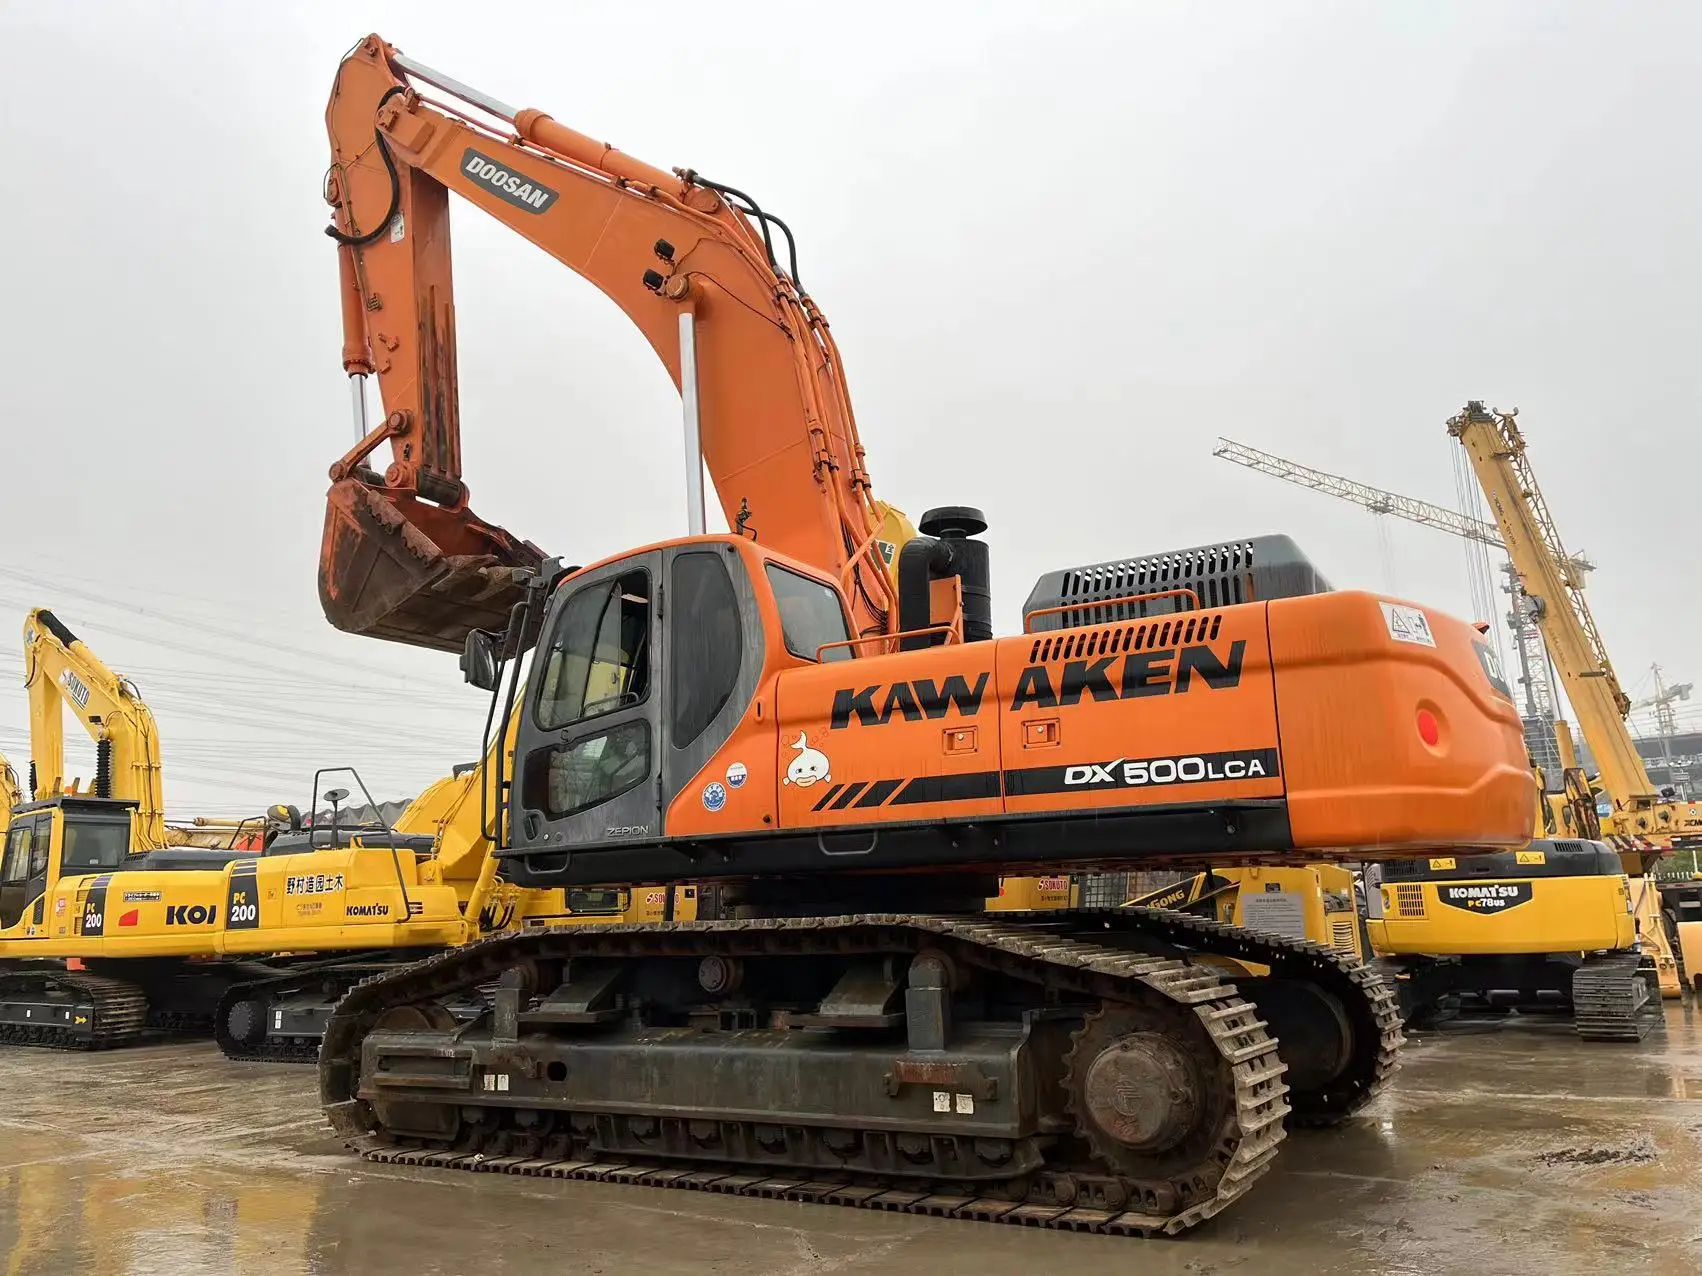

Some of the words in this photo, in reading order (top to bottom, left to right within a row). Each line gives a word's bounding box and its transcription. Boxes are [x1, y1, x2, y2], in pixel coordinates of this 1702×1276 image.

[465, 156, 549, 209] DOOSAN
[607, 825, 649, 837] ZEPION
[286, 874, 344, 895] 野村造园土木
[1449, 885, 1518, 898] KOMATSU
[233, 892, 246, 904] PC
[86, 903, 95, 914] PC
[166, 905, 217, 925] KOI
[231, 905, 256, 922] 200
[346, 903, 389, 917] KOMATSU
[85, 914, 102, 928] 200
